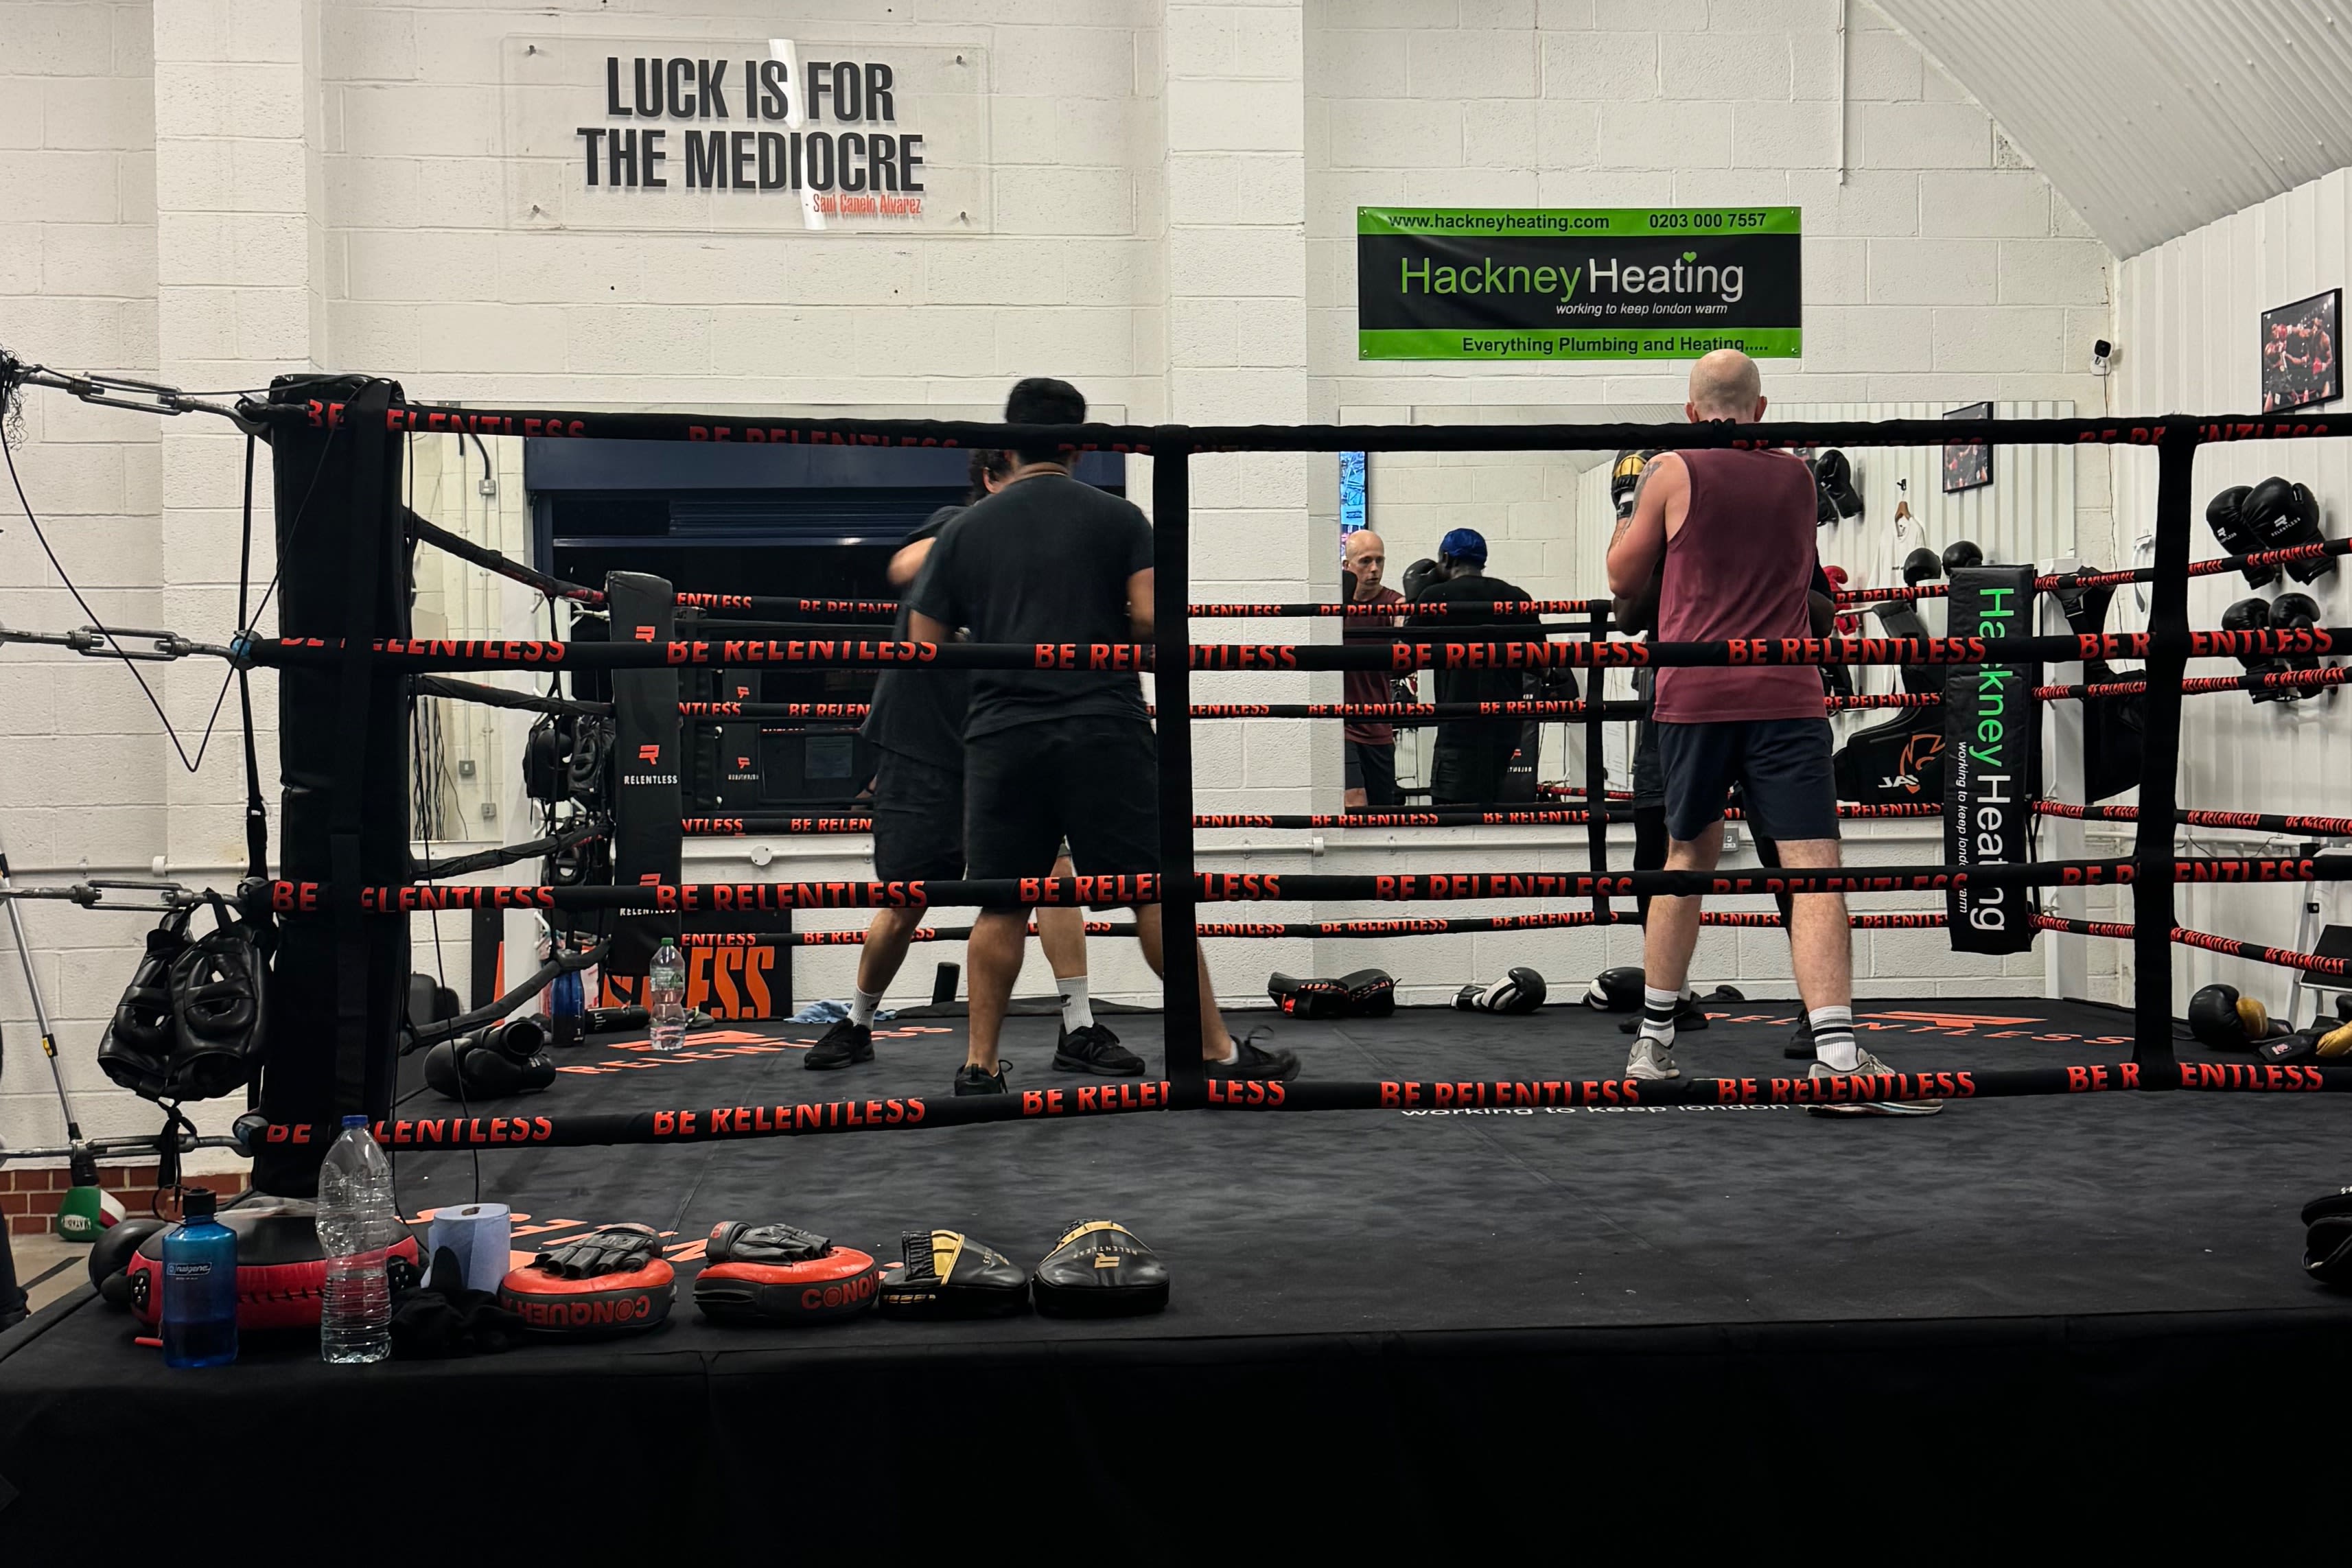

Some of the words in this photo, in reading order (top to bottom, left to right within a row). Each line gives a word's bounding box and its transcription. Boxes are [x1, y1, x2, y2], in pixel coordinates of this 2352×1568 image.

[607, 57, 729, 118] LUCK
[746, 60, 789, 121] IS
[808, 61, 895, 121] FOR
[577, 127, 667, 187] THE
[685, 130, 924, 192] MEDIOCRE
[813, 194, 837, 213] Saul
[840, 194, 876, 213] Canelo
[879, 194, 921, 214] Alvarez
[1389, 213, 1609, 231] www.hackneyheating.com
[1649, 213, 1688, 229] 0203
[1693, 213, 1723, 229] 000
[1727, 213, 1767, 229] 7557
[1401, 257, 1581, 302] Hackney
[1588, 258, 1744, 302] Heating
[1556, 303, 1602, 317] working
[1605, 303, 1616, 315] to
[1620, 303, 1650, 317] keep
[1651, 302, 1692, 316] london
[1695, 305, 1727, 314] warm
[1463, 337, 1555, 353] Everything
[1559, 336, 1639, 353] Plumbing
[1643, 337, 1673, 351] and
[386, 410, 583, 436] ELENTLESS
[373, 638, 566, 663] LENTLESS
[666, 640, 710, 664] BE
[723, 640, 937, 663] RELENTLESS
[1034, 643, 1075, 669] BE
[1089, 643, 1296, 670] RELTLESS
[1391, 643, 1432, 669] BE
[1445, 641, 1650, 668] RELENTLESS
[1727, 639, 1767, 664] BE
[1782, 637, 1987, 664] RELENTLESS
[2077, 633, 2119, 659] BE
[2130, 627, 2333, 657] RENTLESS
[1968, 588, 2015, 767] Hakney
[1955, 741, 1969, 788] working
[624, 775, 678, 785] RELENTLESS
[1957, 791, 1968, 802] to
[1955, 805, 1968, 834] keep
[1969, 775, 2012, 931] Heatng
[2115, 858, 2314, 882] RENTLESS
[272, 880, 318, 911] BE
[361, 885, 554, 913] ELENTLESS
[656, 885, 699, 911] BE
[712, 880, 927, 913] RELENTLESS
[1019, 876, 1060, 902] BE
[1073, 871, 1280, 902] RELELESS
[1374, 874, 1415, 898] BE
[1428, 873, 1633, 898] RELENTLESS
[1959, 888, 1968, 913] arm
[1716, 1079, 1758, 1103] BE
[1770, 1070, 1975, 1102] RELENTLESS
[2066, 1064, 2108, 1092] BE
[2119, 1062, 2324, 1090] RENTLESS
[1021, 1088, 1063, 1115] BE
[1075, 1078, 1285, 1112] RELELESS
[1379, 1082, 1421, 1106] BE
[1434, 1078, 1639, 1105] RELENTLESS
[653, 1109, 696, 1136] BE
[710, 1099, 926, 1134] RELENTLESS
[1401, 1107, 1534, 1116] working
[373, 1116, 552, 1144] LENTLESS
